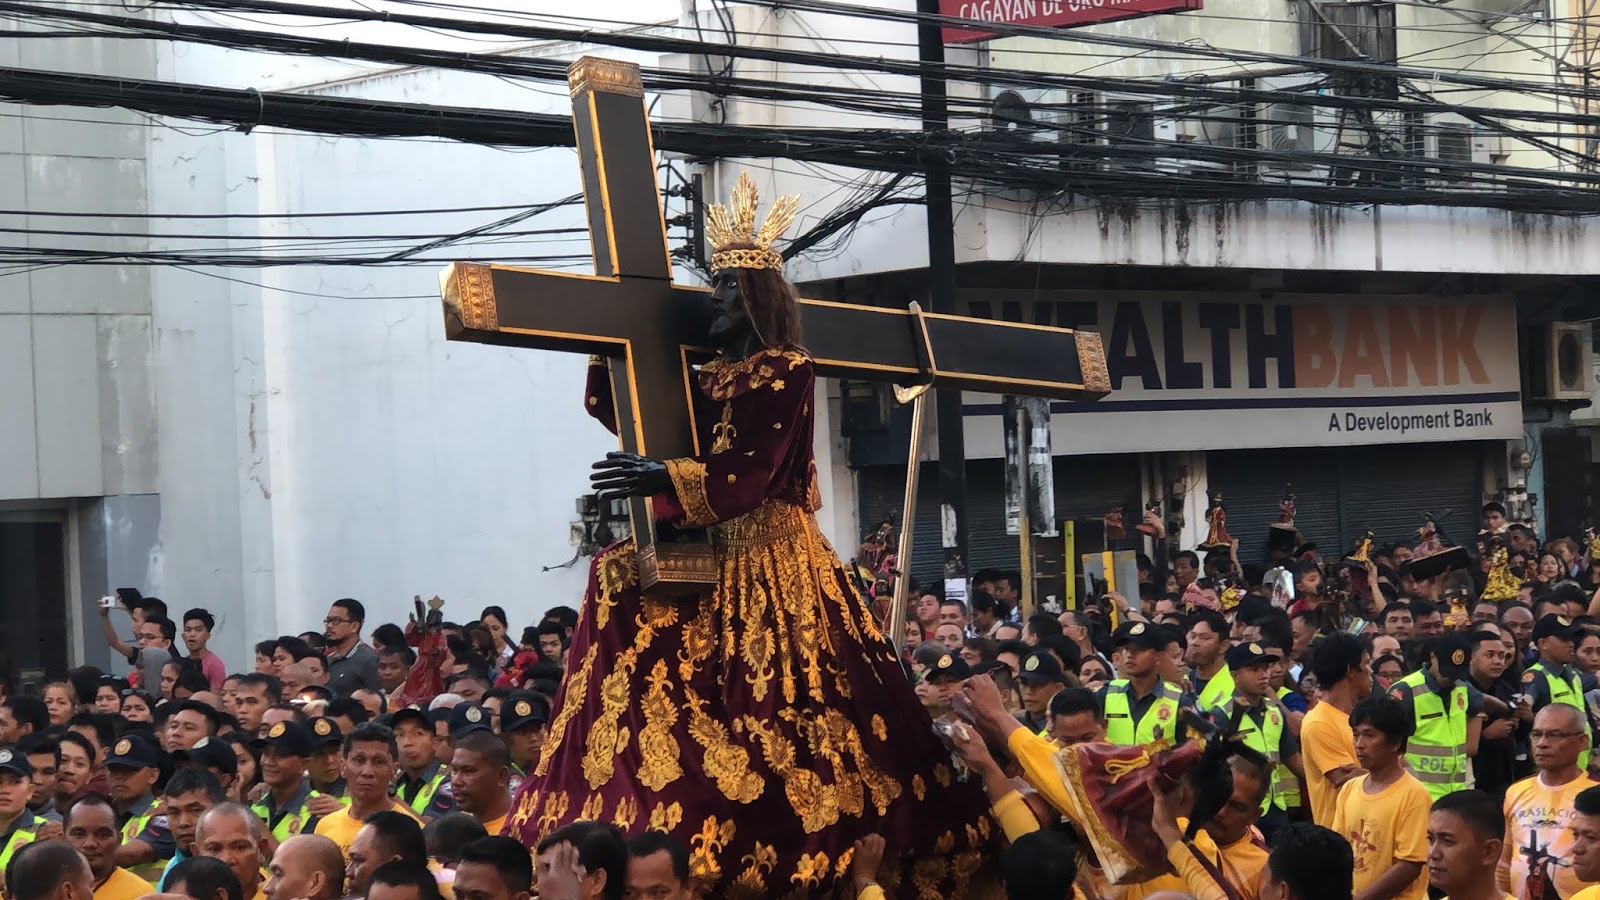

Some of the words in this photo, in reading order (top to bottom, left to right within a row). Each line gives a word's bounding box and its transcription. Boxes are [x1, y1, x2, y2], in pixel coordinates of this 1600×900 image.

[960, 0, 1037, 22] CAGAYAN
[967, 300, 1492, 390] ALTHBANK
[1328, 412, 1341, 432] A
[1345, 411, 1450, 434] Development
[1453, 408, 1493, 427] Bank
[1514, 807, 1576, 820] RASLACIO
